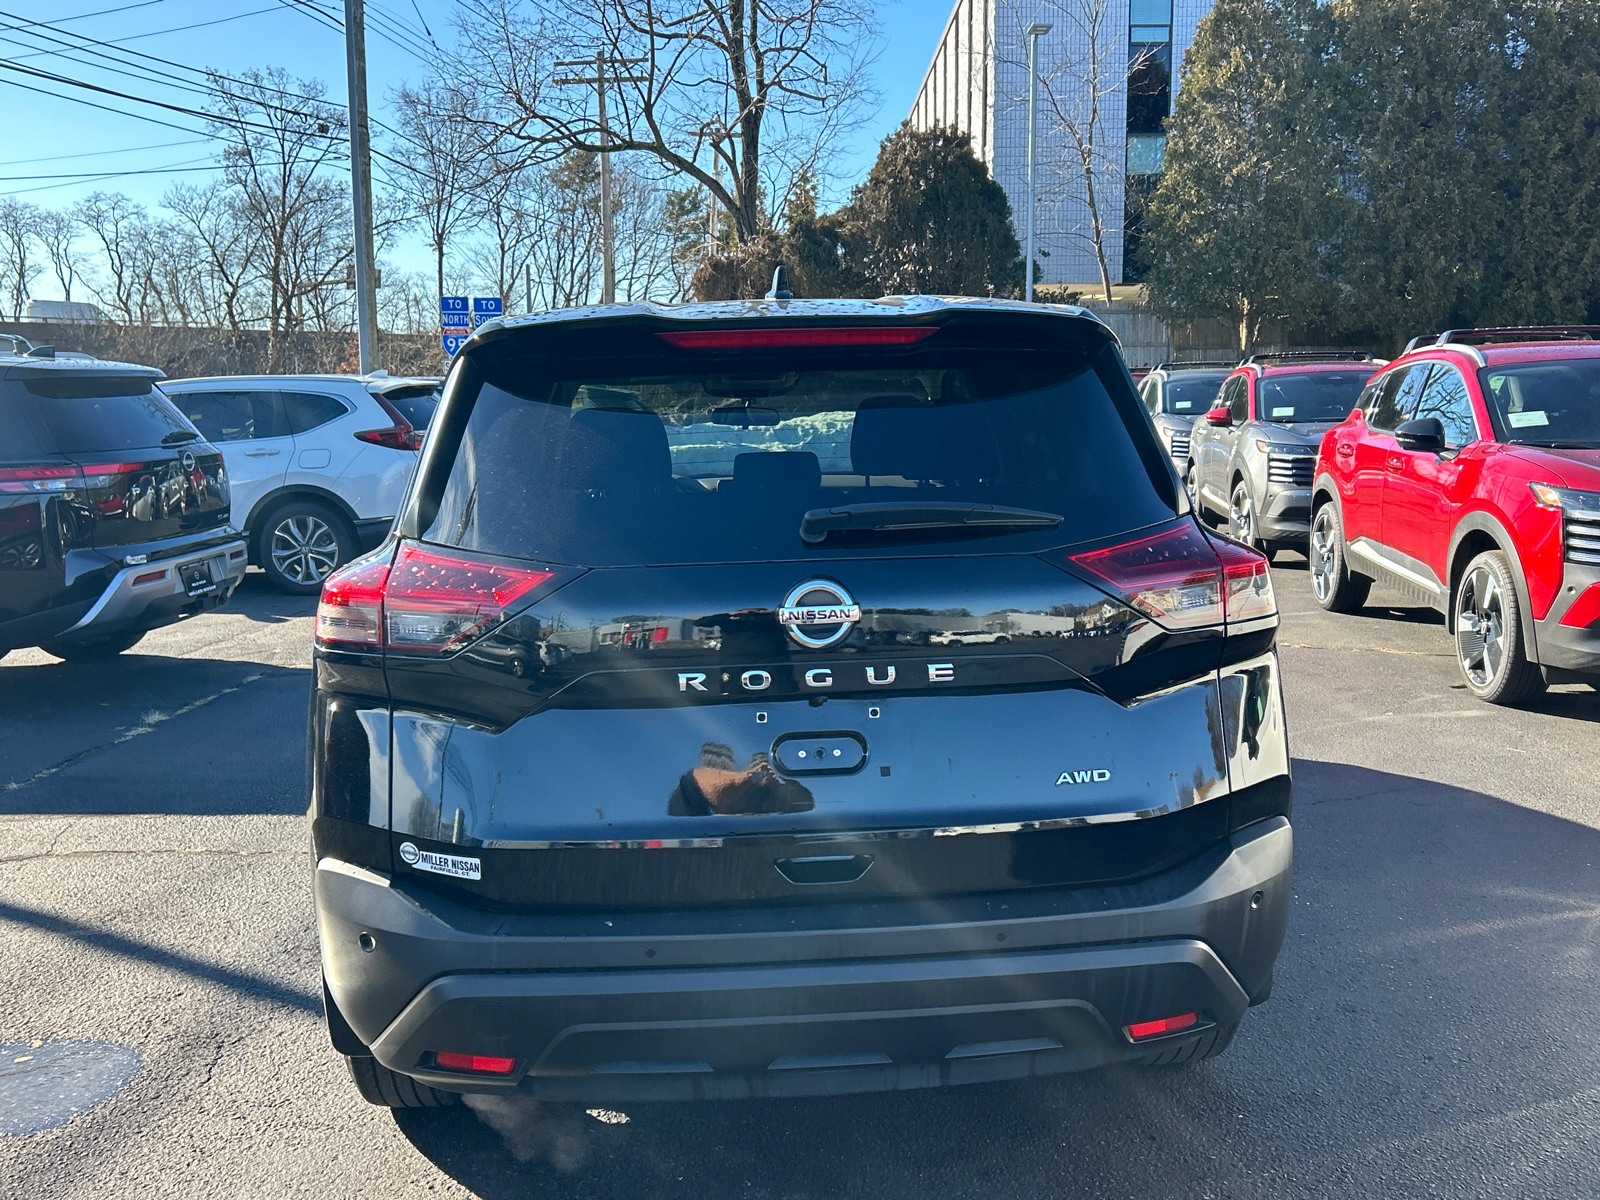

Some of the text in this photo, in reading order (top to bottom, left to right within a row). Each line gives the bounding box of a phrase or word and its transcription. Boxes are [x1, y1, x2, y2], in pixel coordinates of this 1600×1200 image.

[448, 299, 462, 309] TO
[481, 300, 495, 310] TO
[442, 313, 469, 325] NORTH
[786, 608, 851, 621] NISSAN
[678, 663, 955, 692] ROGUE
[1055, 769, 1111, 786] AWD
[421, 853, 449, 867] MILLER
[451, 858, 480, 873] NISSAN
